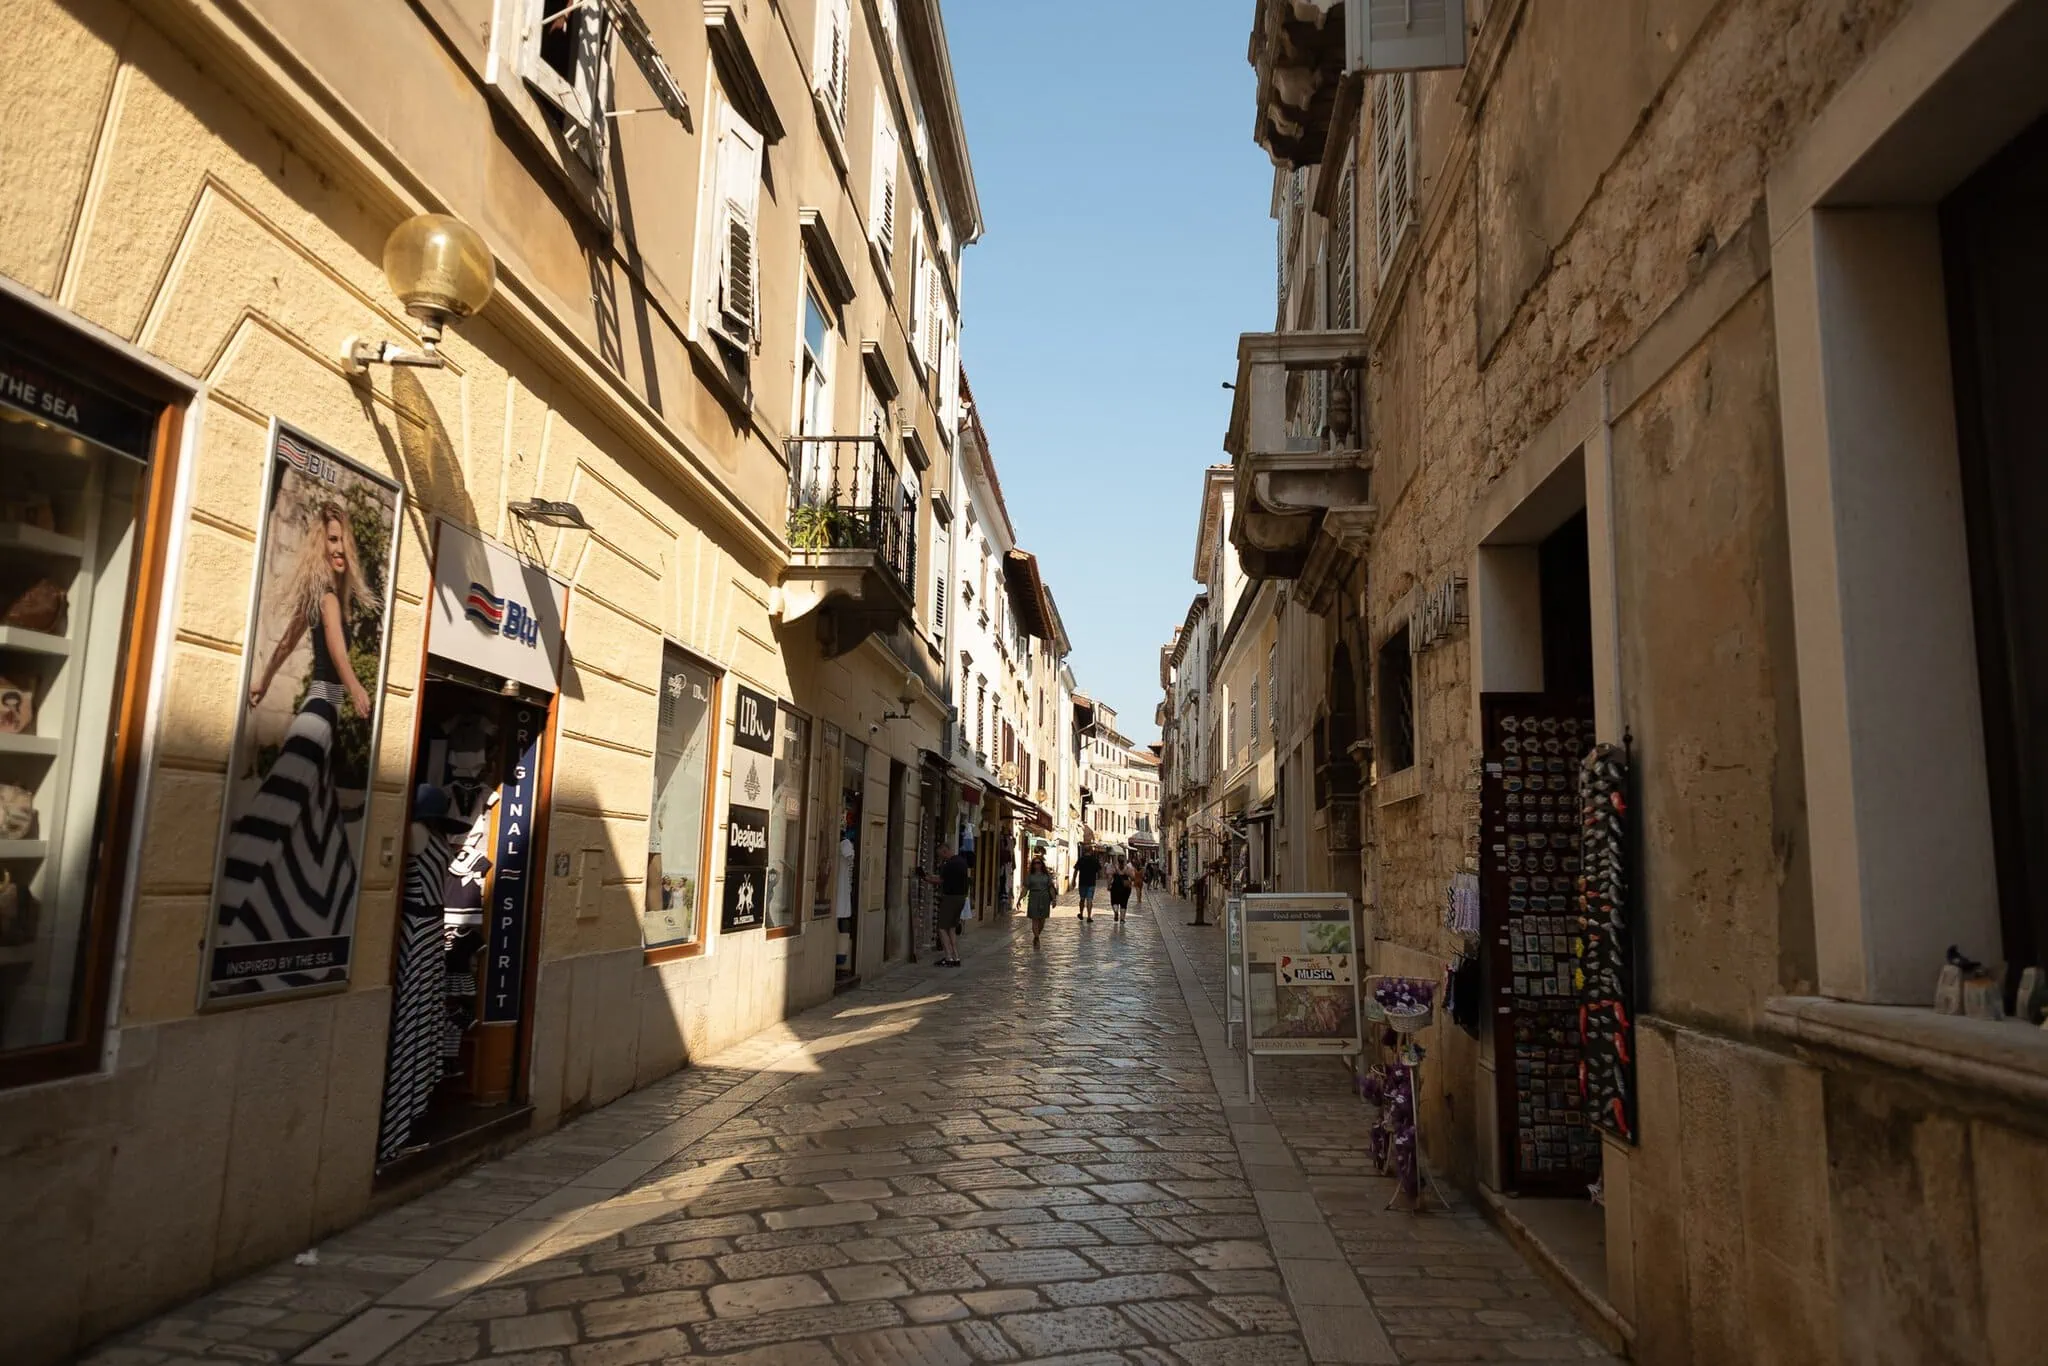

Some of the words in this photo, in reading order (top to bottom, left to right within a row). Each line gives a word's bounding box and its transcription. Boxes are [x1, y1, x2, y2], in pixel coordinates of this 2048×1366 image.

[41, 392, 79, 424] SEA
[308, 453, 336, 485] Blu
[504, 600, 539, 646] Blu
[508, 711, 531, 855] ORIGINAL
[226, 958, 277, 976] INSPIRED
[279, 957, 293, 969] BY
[296, 954, 313, 967] THE
[315, 952, 334, 965] SEA
[496, 897, 514, 1008] SPIRIT
